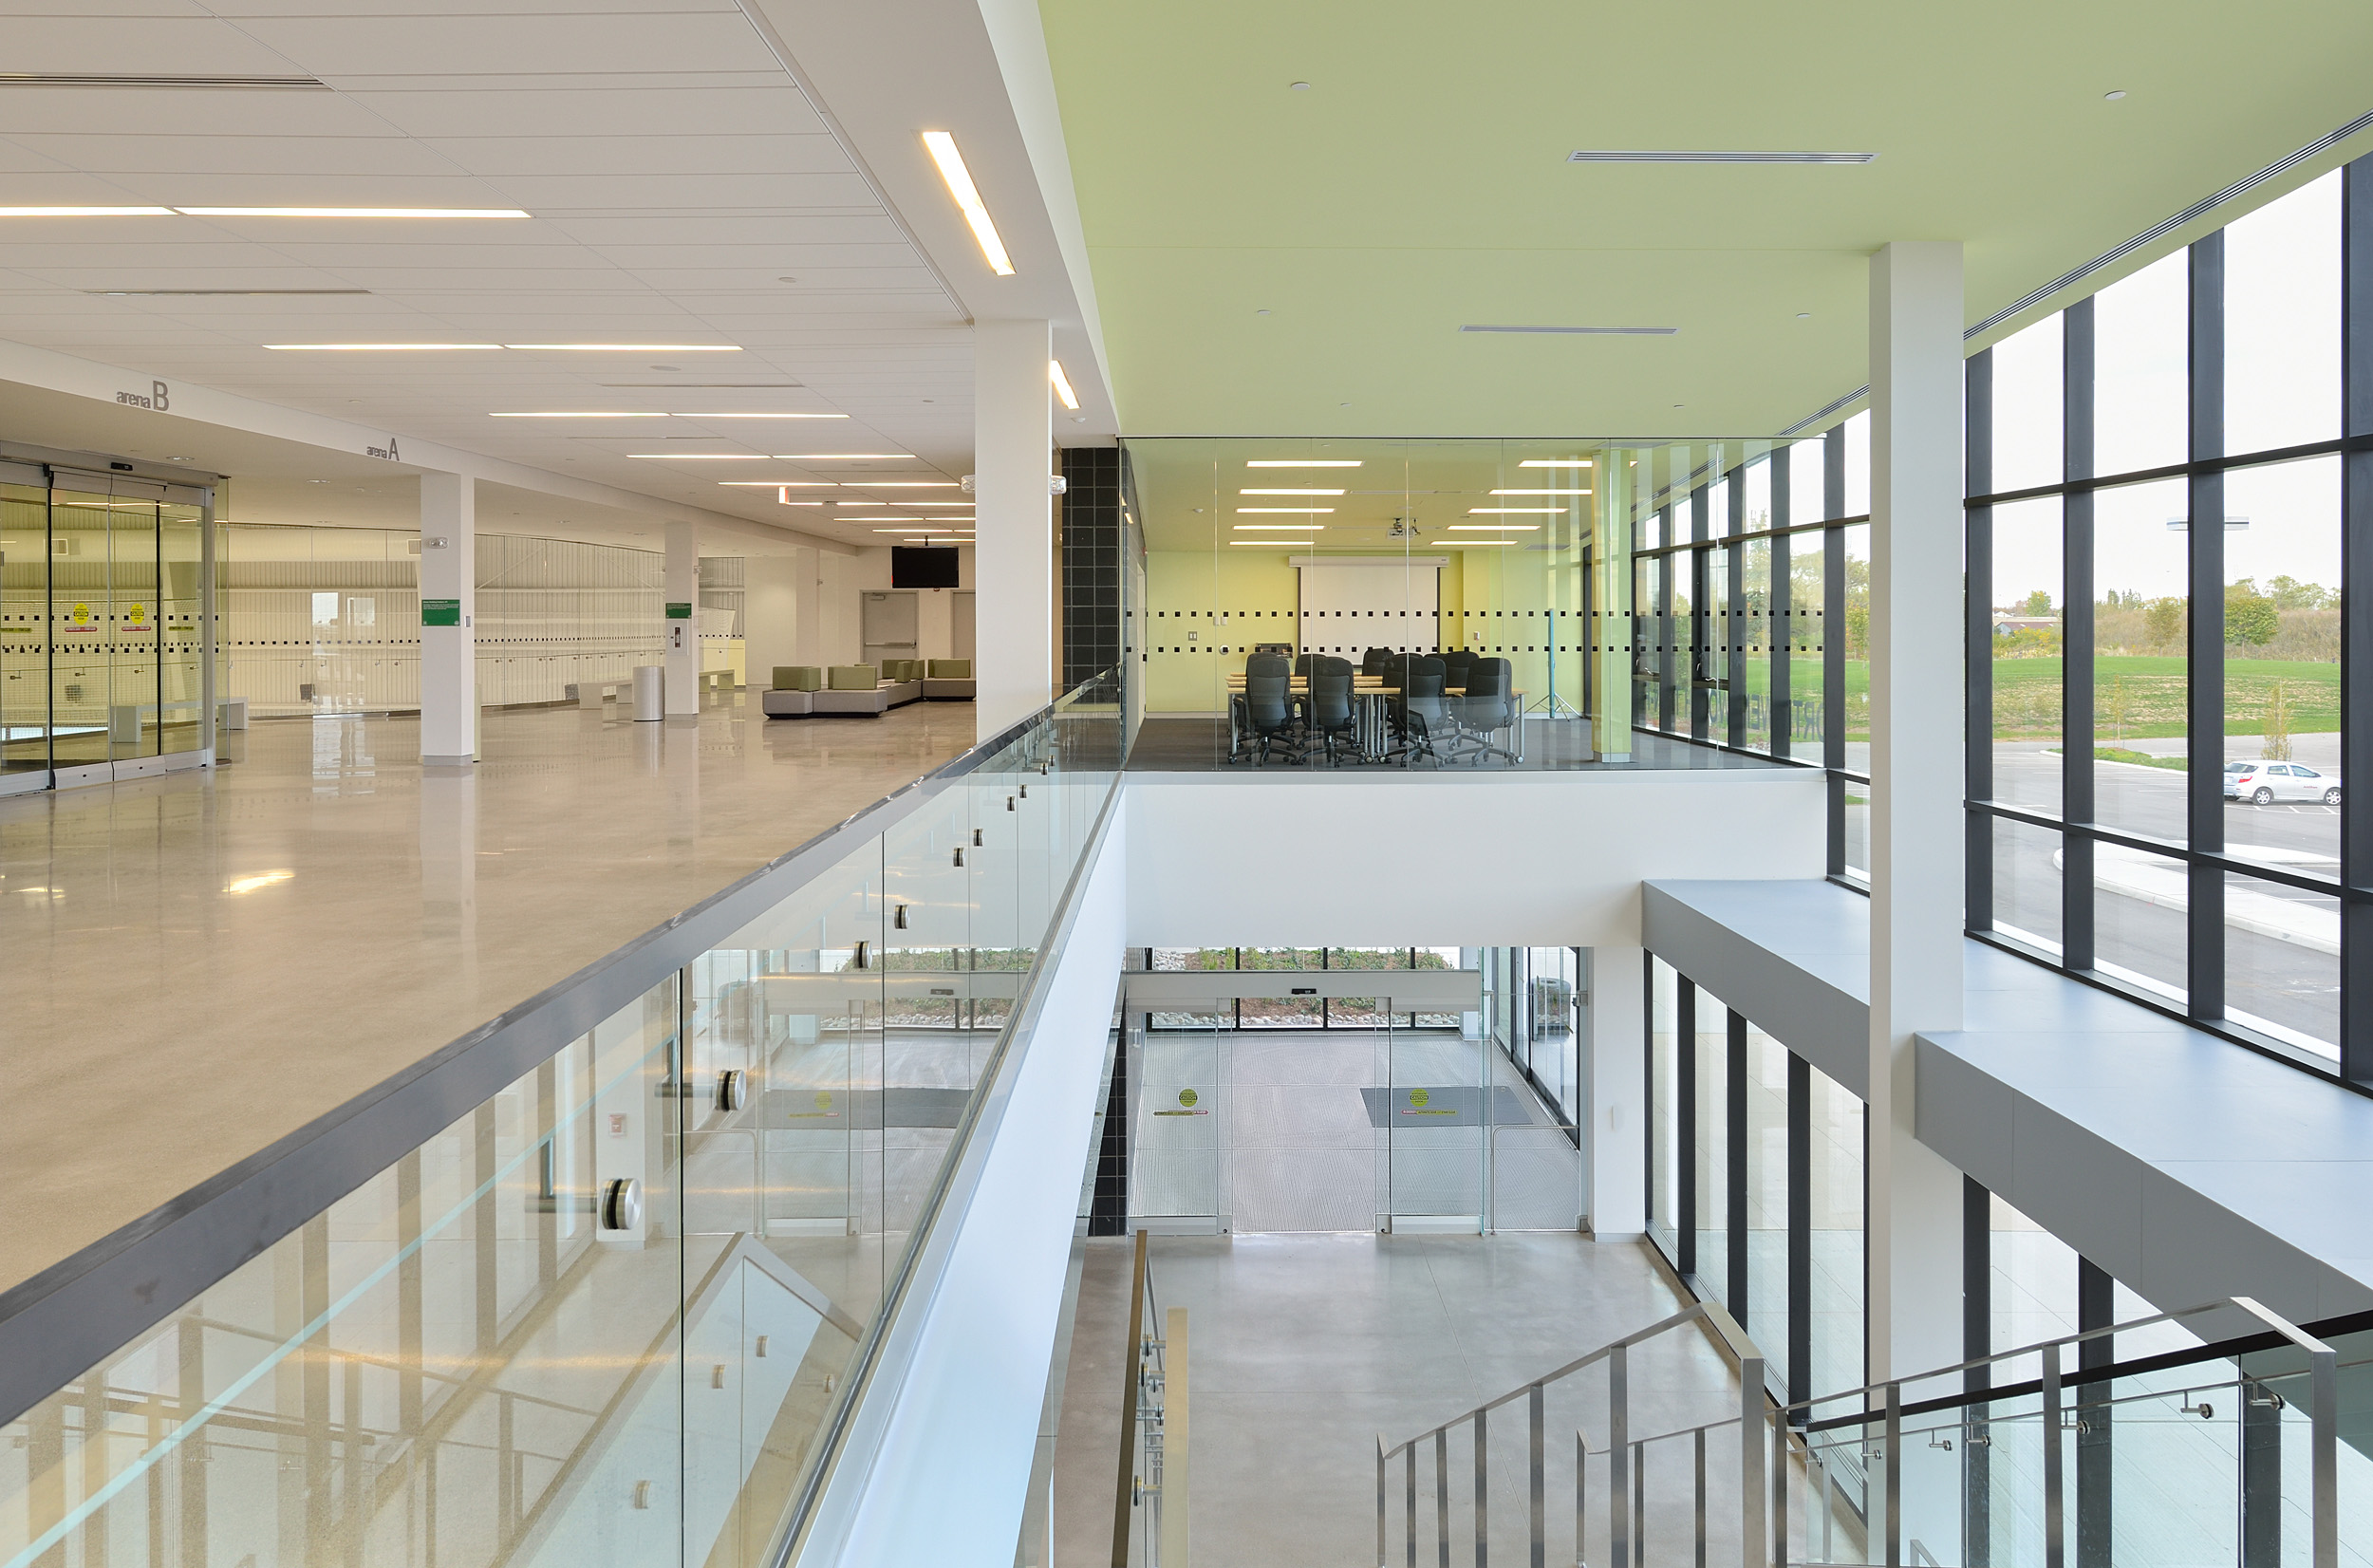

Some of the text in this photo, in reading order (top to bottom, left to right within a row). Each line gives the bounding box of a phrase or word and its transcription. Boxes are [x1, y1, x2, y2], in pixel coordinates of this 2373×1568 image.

[116, 380, 169, 412] arena B
[366, 438, 400, 461] arena A
